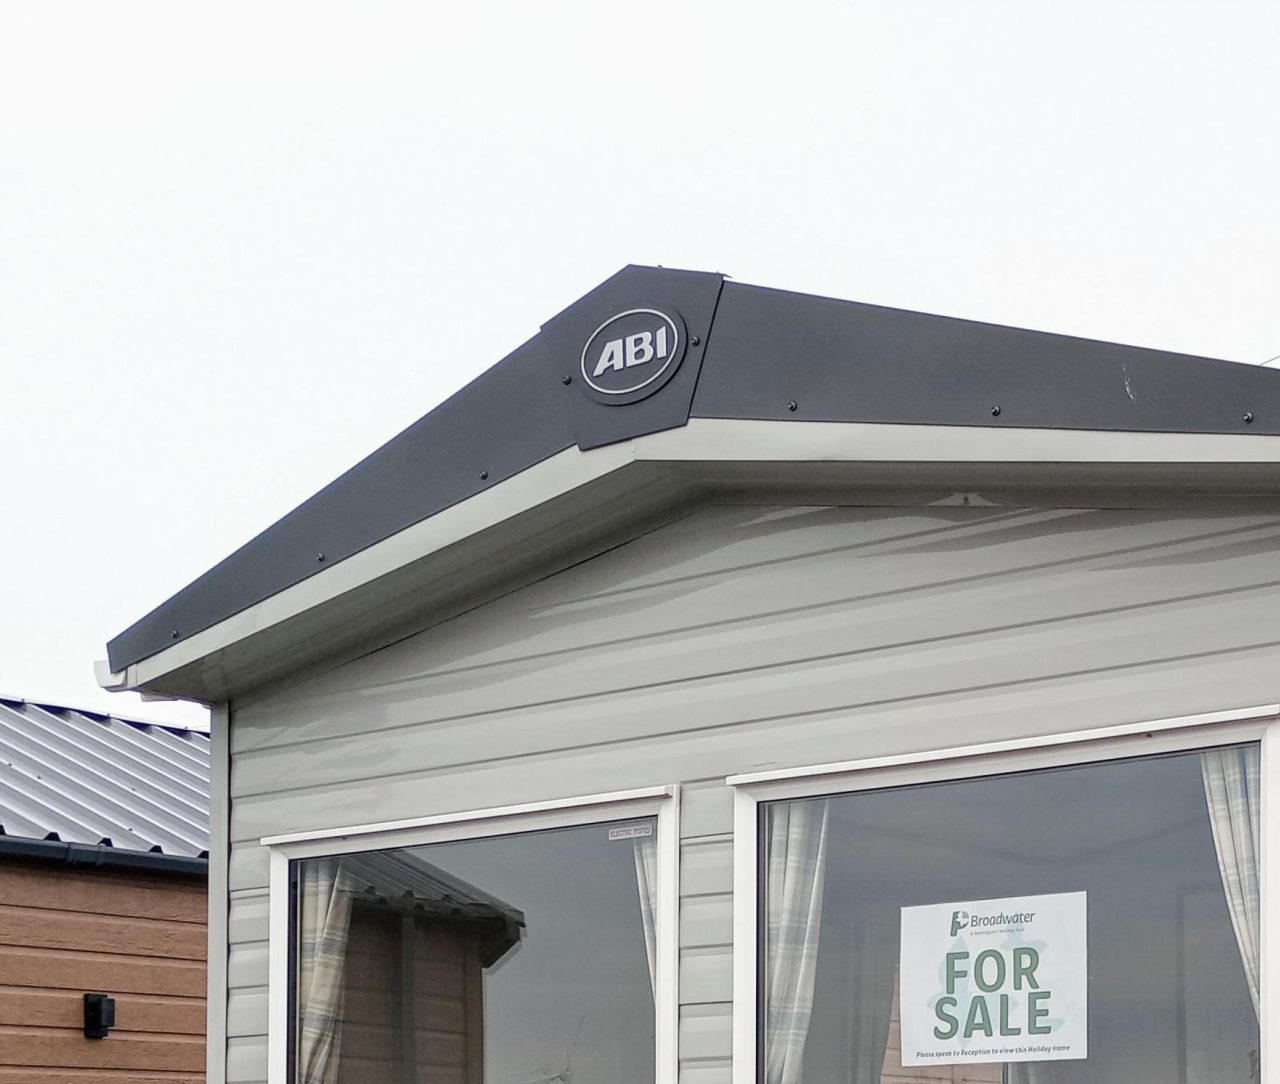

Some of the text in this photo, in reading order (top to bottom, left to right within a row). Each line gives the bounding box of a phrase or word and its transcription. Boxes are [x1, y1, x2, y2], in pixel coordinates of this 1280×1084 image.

[592, 325, 667, 378] ABI
[970, 911, 1036, 928] Broadwater
[945, 946, 1040, 995] FOR
[933, 990, 1052, 1040] SALE
[961, 1048, 991, 1057] Reception
[1015, 1045, 1027, 1053] this
[1028, 1045, 1052, 1054] Holiday
